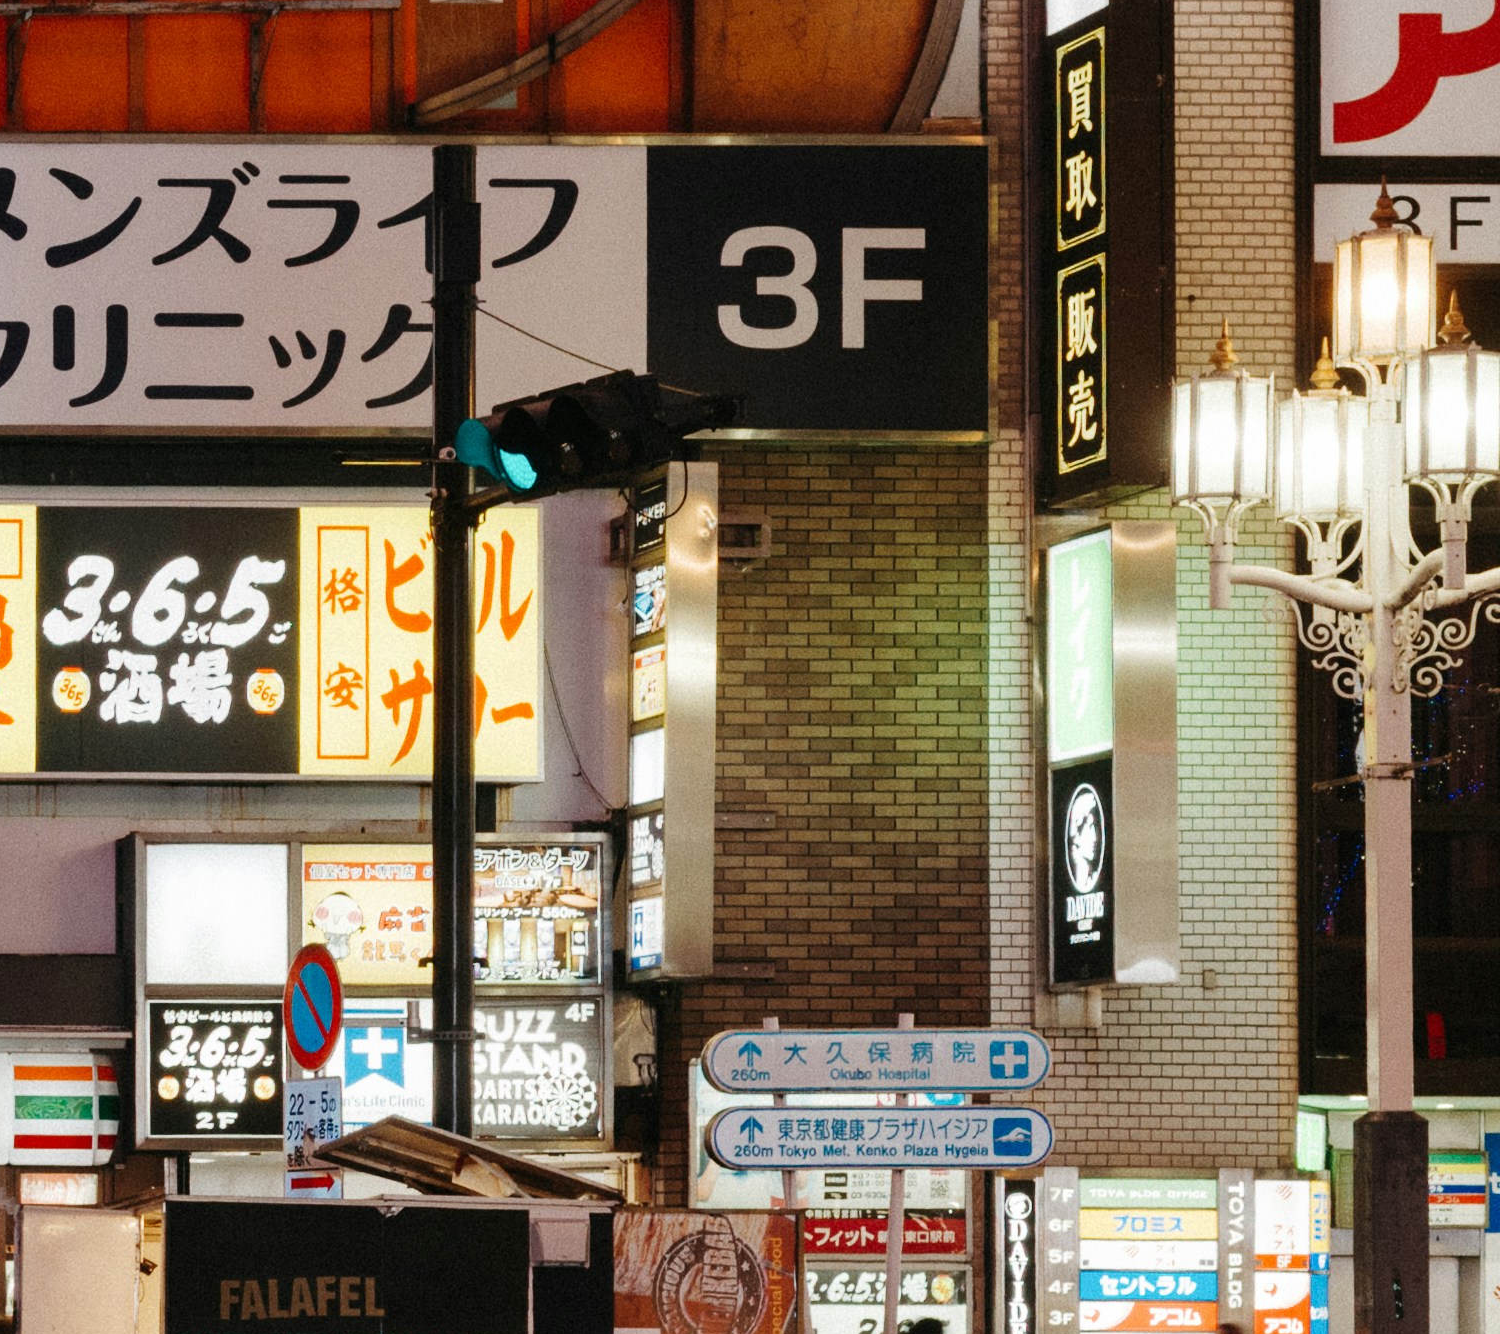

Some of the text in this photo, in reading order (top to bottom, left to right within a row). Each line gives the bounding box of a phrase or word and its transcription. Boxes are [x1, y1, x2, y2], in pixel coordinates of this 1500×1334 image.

[1066, 60, 1097, 222] 買取
[716, 225, 927, 351] 3F
[1066, 288, 1098, 449] 販売
[322, 568, 366, 712] 格安
[99, 649, 234, 726] 酒場
[309, 862, 416, 882] 個室セット専門店
[1065, 894, 1105, 922] DAVIDE
[783, 1041, 977, 1065] 大久保病院
[185, 1068, 247, 1104] 酒場
[731, 1069, 771, 1082] 260m
[829, 1067, 931, 1082] Okubo Hospital
[777, 1117, 989, 1142] 東京都健康プラザハイジア
[734, 1144, 989, 1159] 260m Tokyo Met. Kenko Plaza Hygeia
[1112, 1215, 1184, 1235] プロミス
[1228, 1181, 1244, 1309] TOYA BLDG
[768, 1236, 784, 1282] Food
[218, 1275, 385, 1321] FALAFEL
[1098, 1275, 1198, 1297] セントラル
[1149, 1307, 1202, 1327] アコム
[1263, 1317, 1304, 1334] アコム
